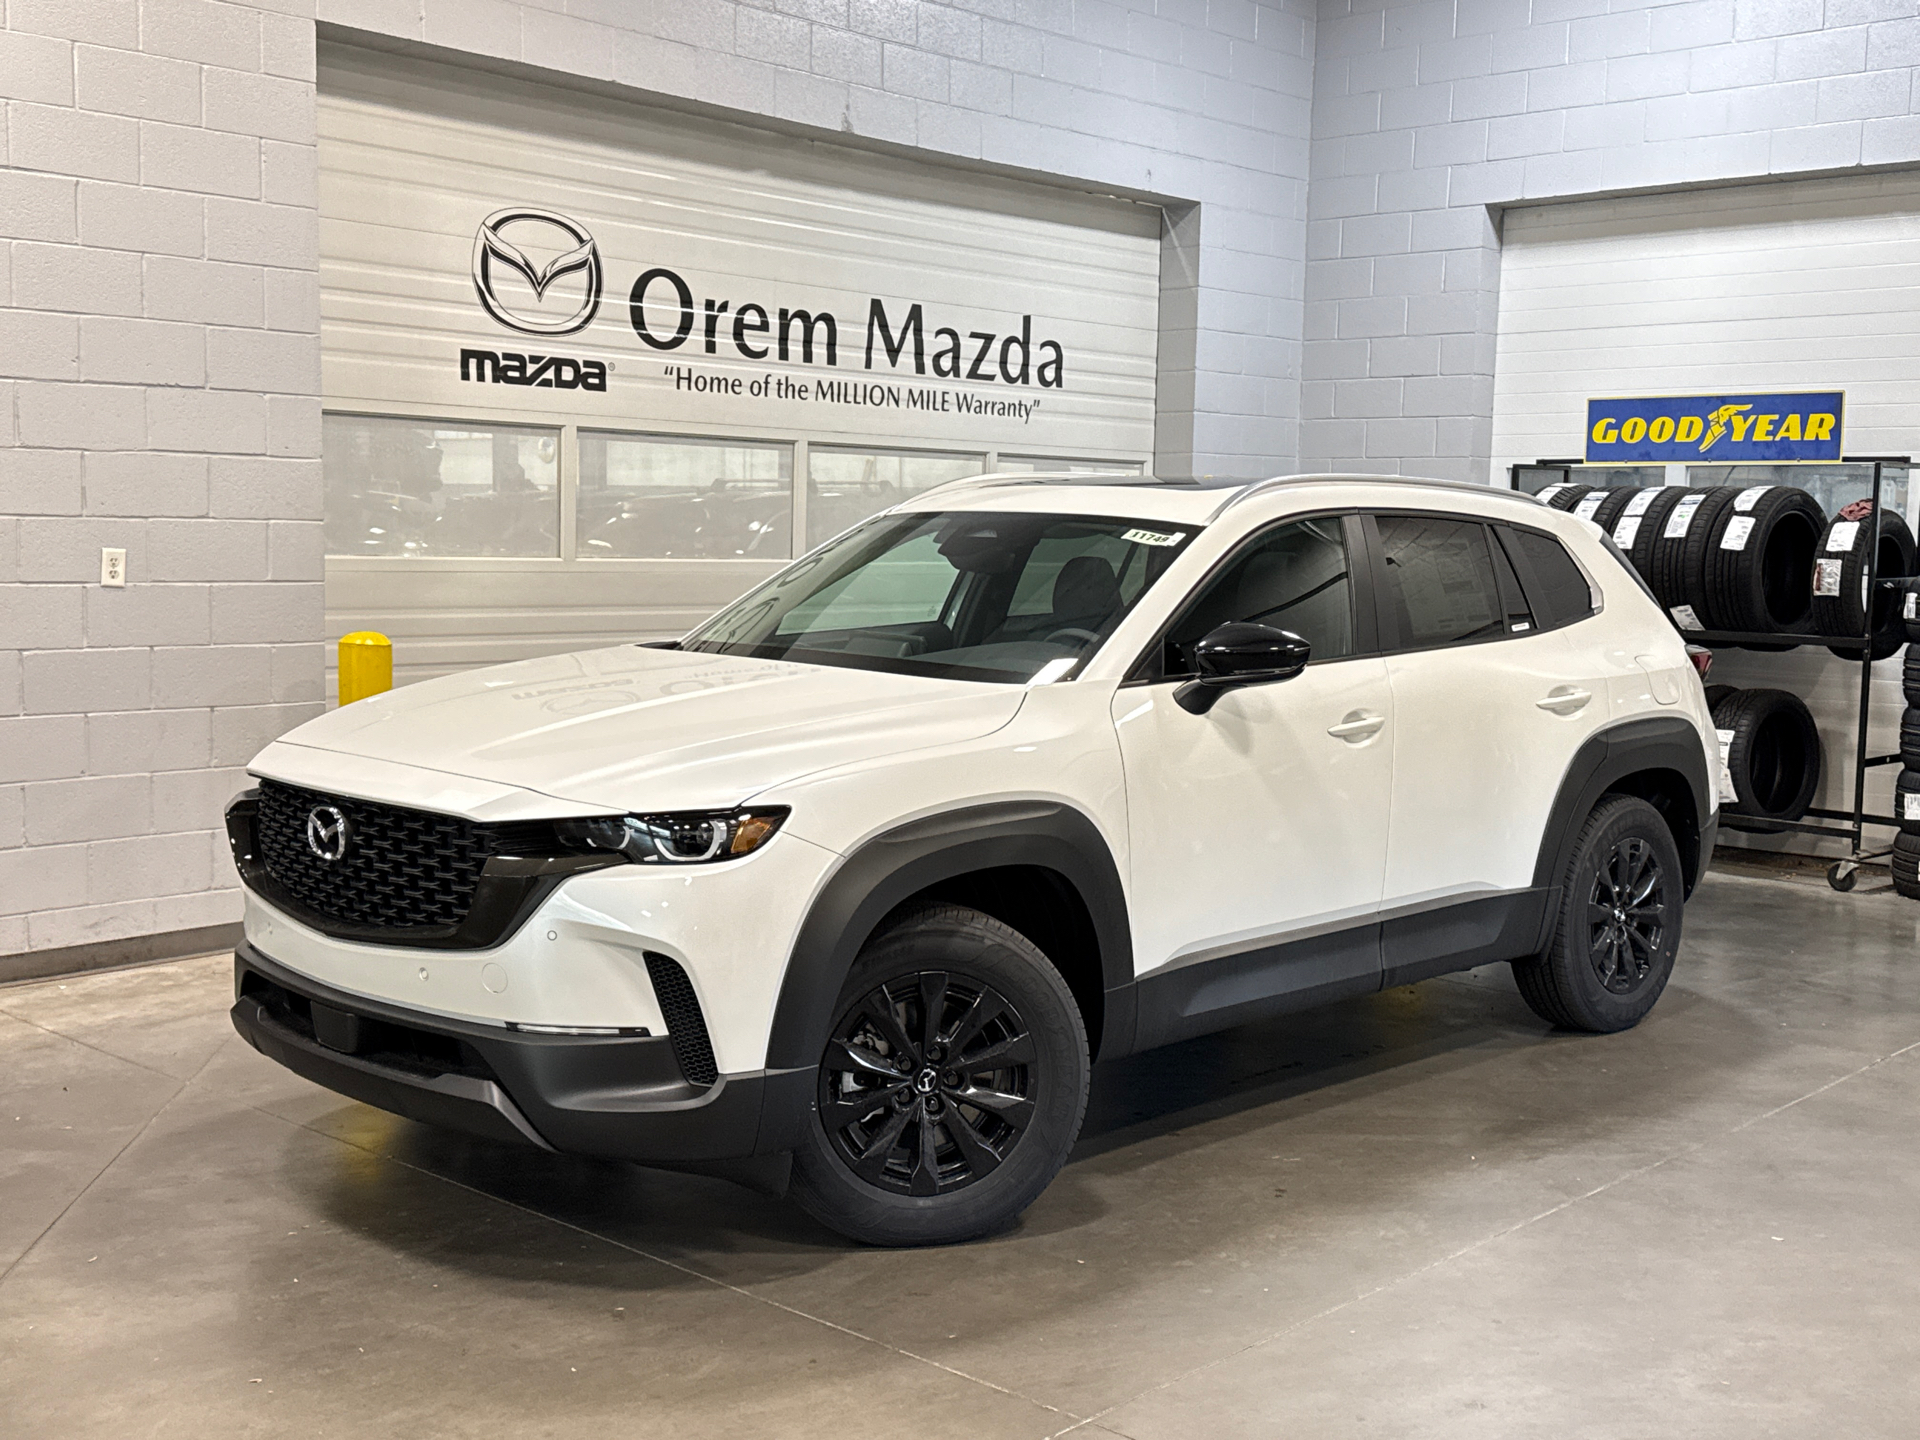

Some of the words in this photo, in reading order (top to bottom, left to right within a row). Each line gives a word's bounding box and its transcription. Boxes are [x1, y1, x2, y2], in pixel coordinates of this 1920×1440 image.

[629, 266, 837, 367] Orem
[863, 297, 1064, 388] Mazda
[749, 374, 772, 398] of
[776, 376, 809, 401] the
[814, 379, 900, 408] MILLION
[906, 388, 950, 412] MILE
